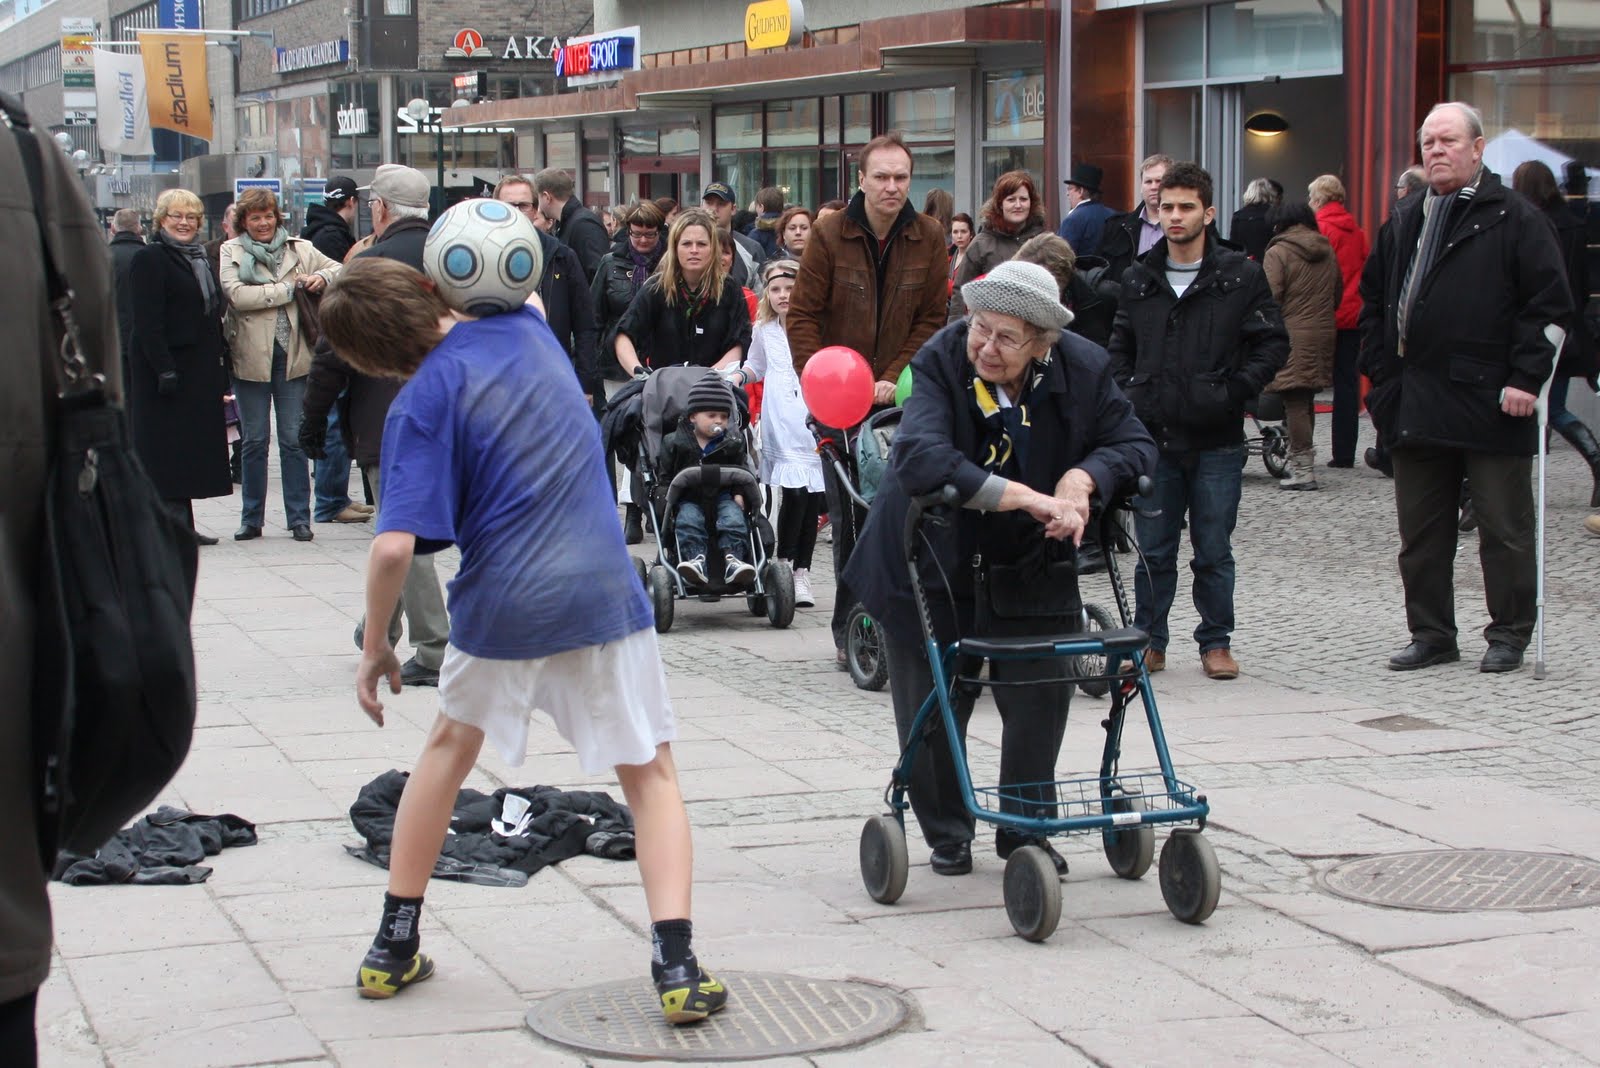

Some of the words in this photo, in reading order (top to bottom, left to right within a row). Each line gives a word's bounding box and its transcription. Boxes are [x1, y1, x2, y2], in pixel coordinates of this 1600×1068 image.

[748, 12, 788, 42] GULDFYND
[502, 35, 574, 59] AKA
[564, 39, 620, 77] INTERSPORT
[165, 43, 188, 128] stadium
[1022, 85, 1044, 118] tele
[336, 103, 368, 135] stadium
